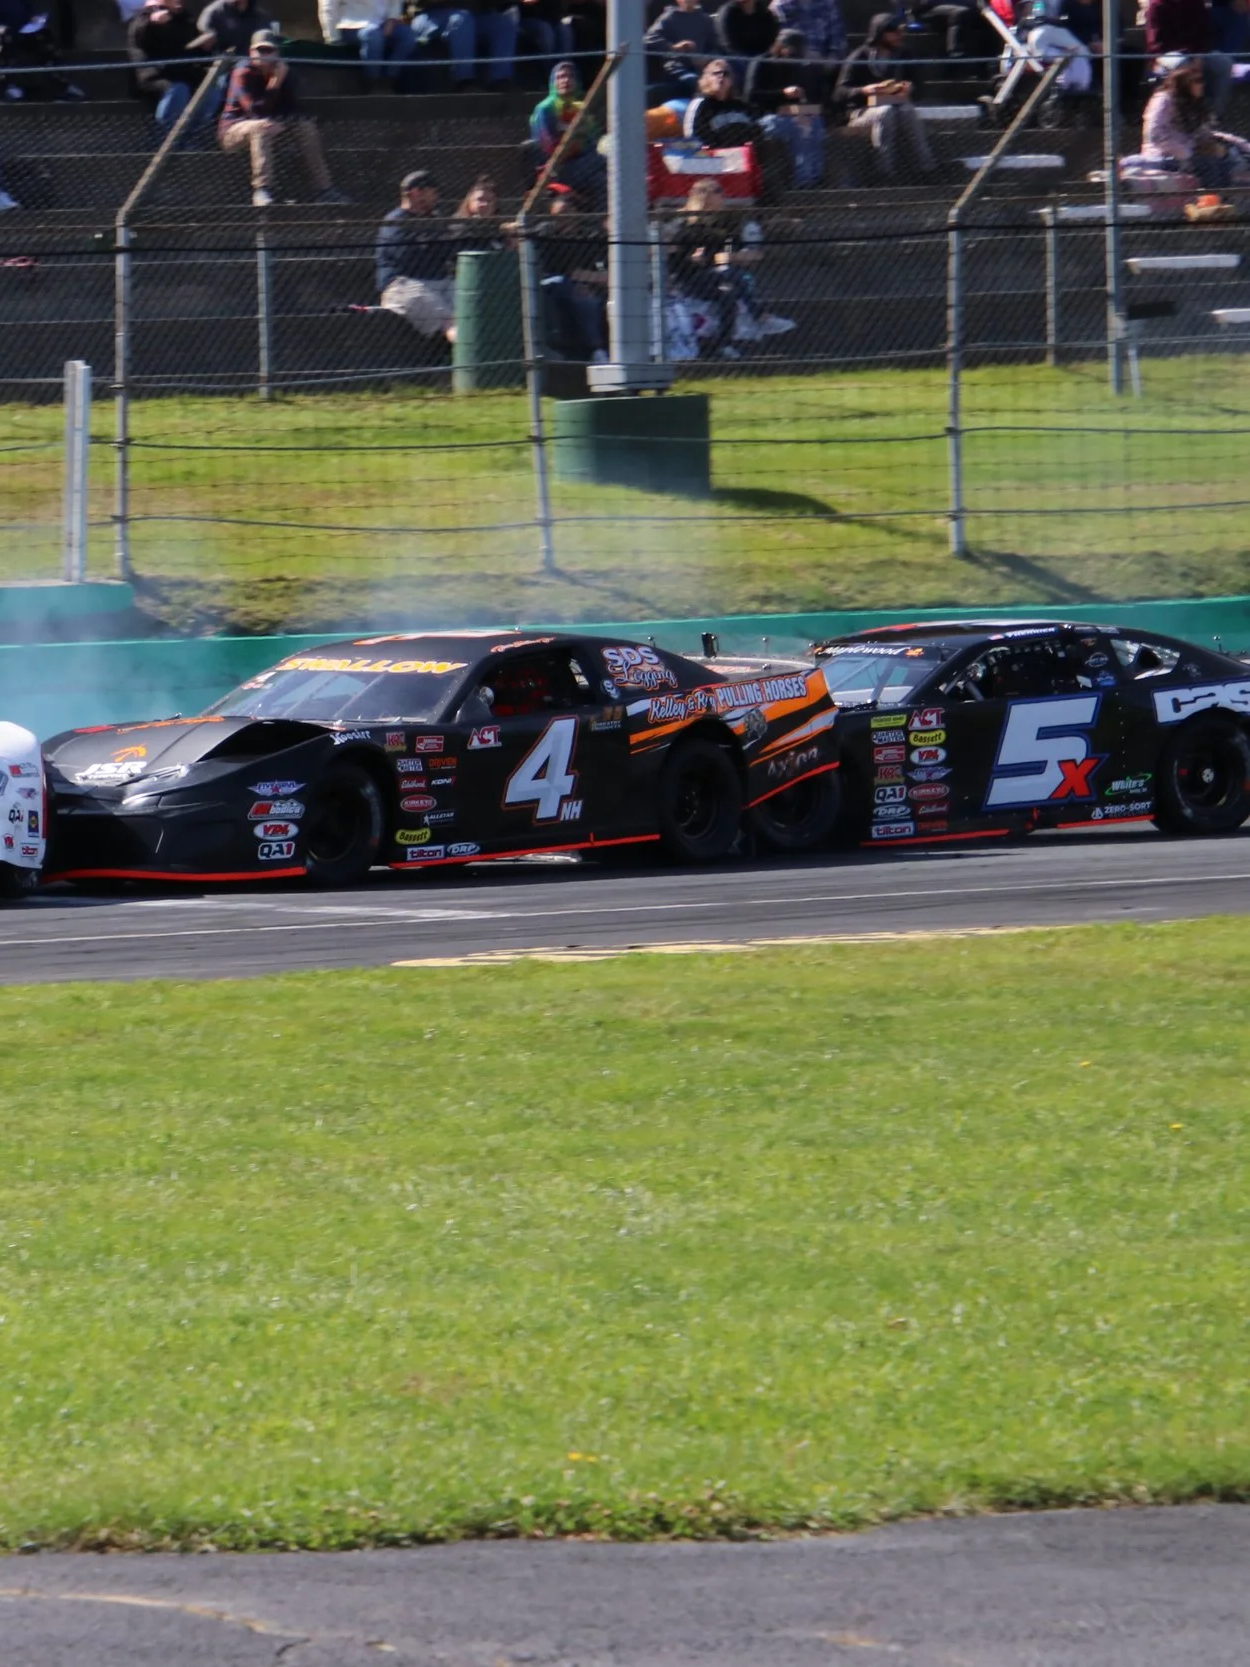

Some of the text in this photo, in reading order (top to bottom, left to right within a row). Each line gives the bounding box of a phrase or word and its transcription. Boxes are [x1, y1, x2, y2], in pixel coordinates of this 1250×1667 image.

[602, 645, 659, 667] SDS
[607, 660, 678, 689] Logging
[649, 696, 686, 722] Kelley
[715, 681, 762, 711] PULLING
[764, 674, 807, 703] HORSES
[909, 708, 945, 729] ACT
[467, 727, 501, 748] ACT
[913, 733, 942, 742] Bassett
[986, 697, 1098, 805] 5
[505, 719, 582, 820] 4 NH
[876, 788, 904, 801] QA1
[1105, 802, 1152, 813] ZERO-SORT
[400, 831, 427, 841] Bassett
[877, 825, 910, 835] tilton
[261, 843, 292, 857] QA1
[411, 849, 441, 858] tilton
